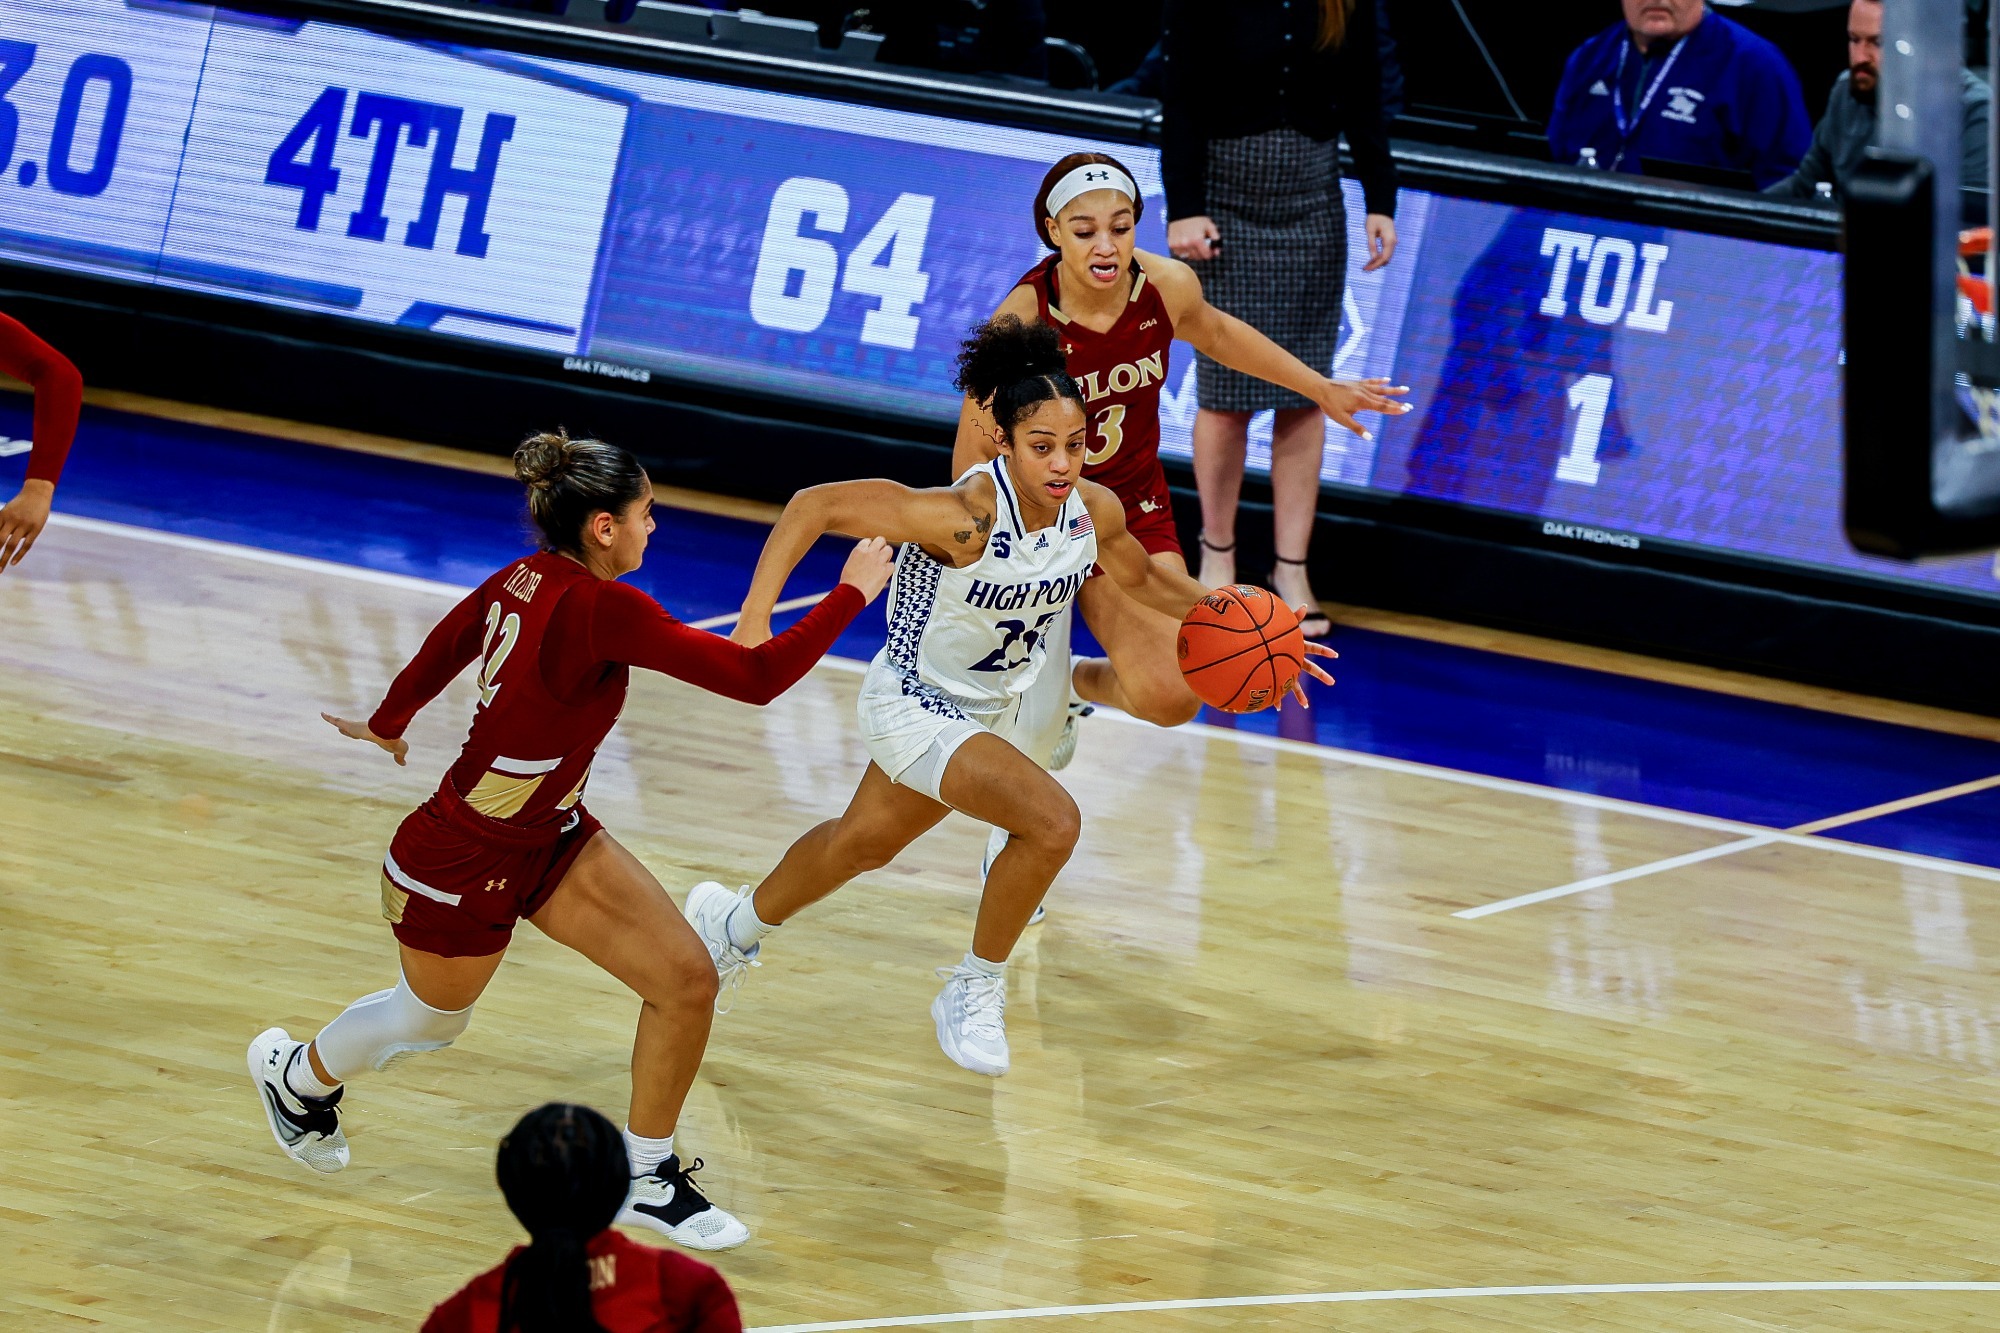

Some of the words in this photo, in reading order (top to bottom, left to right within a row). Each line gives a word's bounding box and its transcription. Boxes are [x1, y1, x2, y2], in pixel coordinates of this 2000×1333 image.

[264, 86, 516, 258] 4TH
[749, 176, 934, 350] 64
[1539, 228, 1673, 333] TOL
[1139, 318, 1158, 331] CAA
[1084, 404, 1127, 466] 3
[1556, 373, 1614, 485] 1
[964, 579, 1032, 610] HIGH
